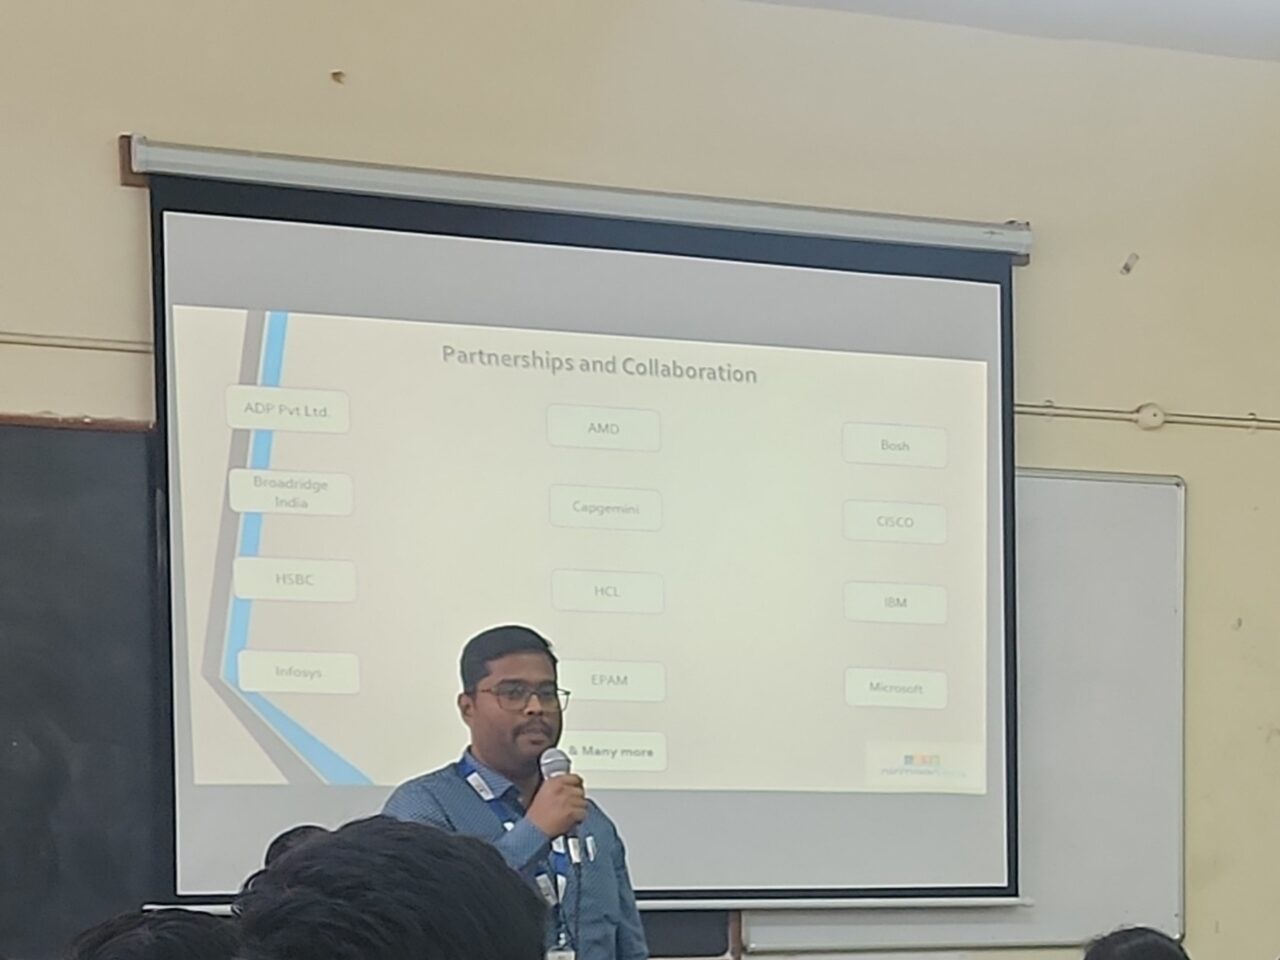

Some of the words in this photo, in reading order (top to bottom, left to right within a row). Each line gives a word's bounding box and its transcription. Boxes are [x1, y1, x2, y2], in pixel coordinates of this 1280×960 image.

[442, 345, 575, 376] Partnerships
[579, 356, 617, 374] and
[621, 356, 758, 384] Collaboration
[243, 402, 275, 415] ADP
[278, 403, 301, 416] Pvt
[587, 422, 620, 435] AMD
[880, 438, 911, 452] Bosh
[252, 475, 329, 494] Broadridge
[274, 496, 309, 509] India
[571, 499, 641, 516] Capgemini
[275, 573, 315, 586] HSBC
[593, 585, 621, 598] HCL
[883, 597, 908, 609] IBM
[274, 665, 323, 681] Infosys
[590, 674, 629, 687] EPAM
[868, 680, 924, 695] Microsoft
[568, 745, 578, 756] &
[582, 745, 616, 760] Many
[620, 748, 655, 758] more
